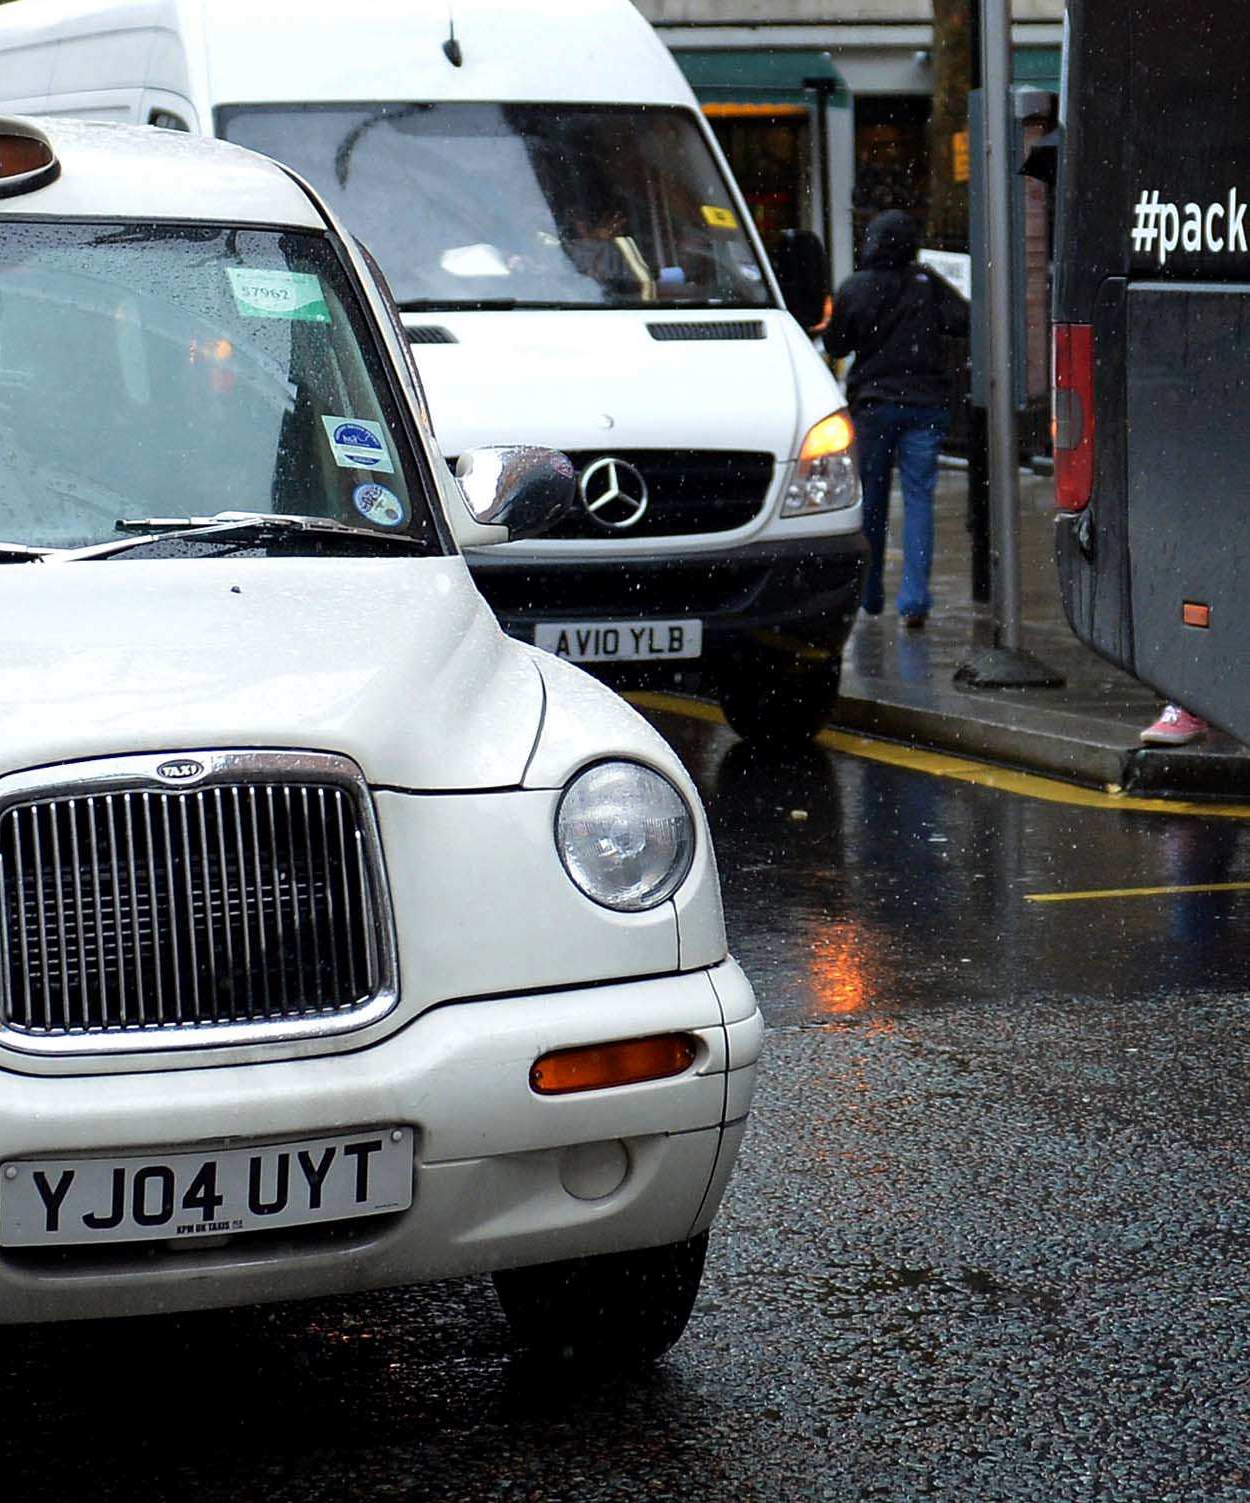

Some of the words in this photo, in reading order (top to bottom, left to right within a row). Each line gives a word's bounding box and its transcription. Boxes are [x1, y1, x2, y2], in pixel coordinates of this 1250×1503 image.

[1131, 186, 1249, 265] #pack
[241, 286, 291, 300] 57962
[556, 629, 620, 657] AV10
[630, 626, 684, 654] YLB
[162, 764, 197, 776] TAXI
[32, 1161, 223, 1231] YJ04
[248, 1140, 382, 1216] UYT
